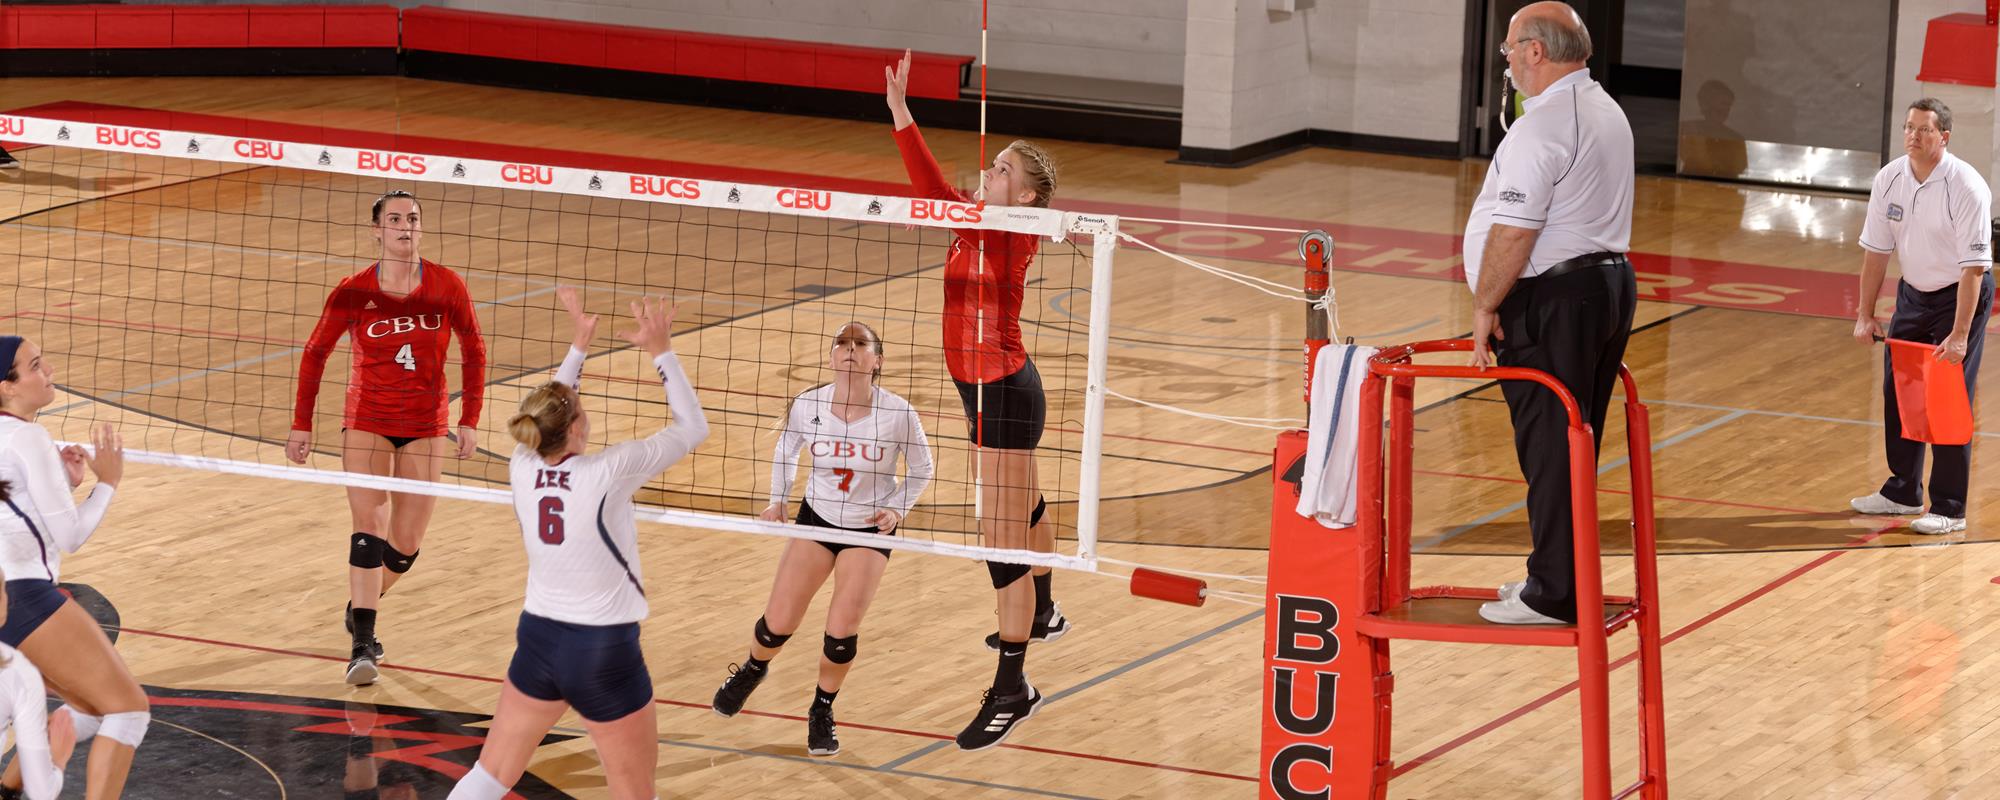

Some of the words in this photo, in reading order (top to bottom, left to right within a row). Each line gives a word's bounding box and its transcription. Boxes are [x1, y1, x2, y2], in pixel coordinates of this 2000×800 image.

[95, 126, 161, 150] BUCS
[233, 139, 284, 161] CBU
[357, 151, 427, 175] BUCS
[500, 163, 553, 185] CBU
[629, 175, 701, 200] BUCS
[775, 188, 832, 211] CBU
[910, 199, 982, 224] BUCS
[366, 314, 443, 338] CBU
[394, 343, 417, 372] 4
[810, 440, 887, 463] CBU
[534, 468, 572, 492] LEE
[832, 467, 855, 493] 7
[538, 496, 565, 546] 6
